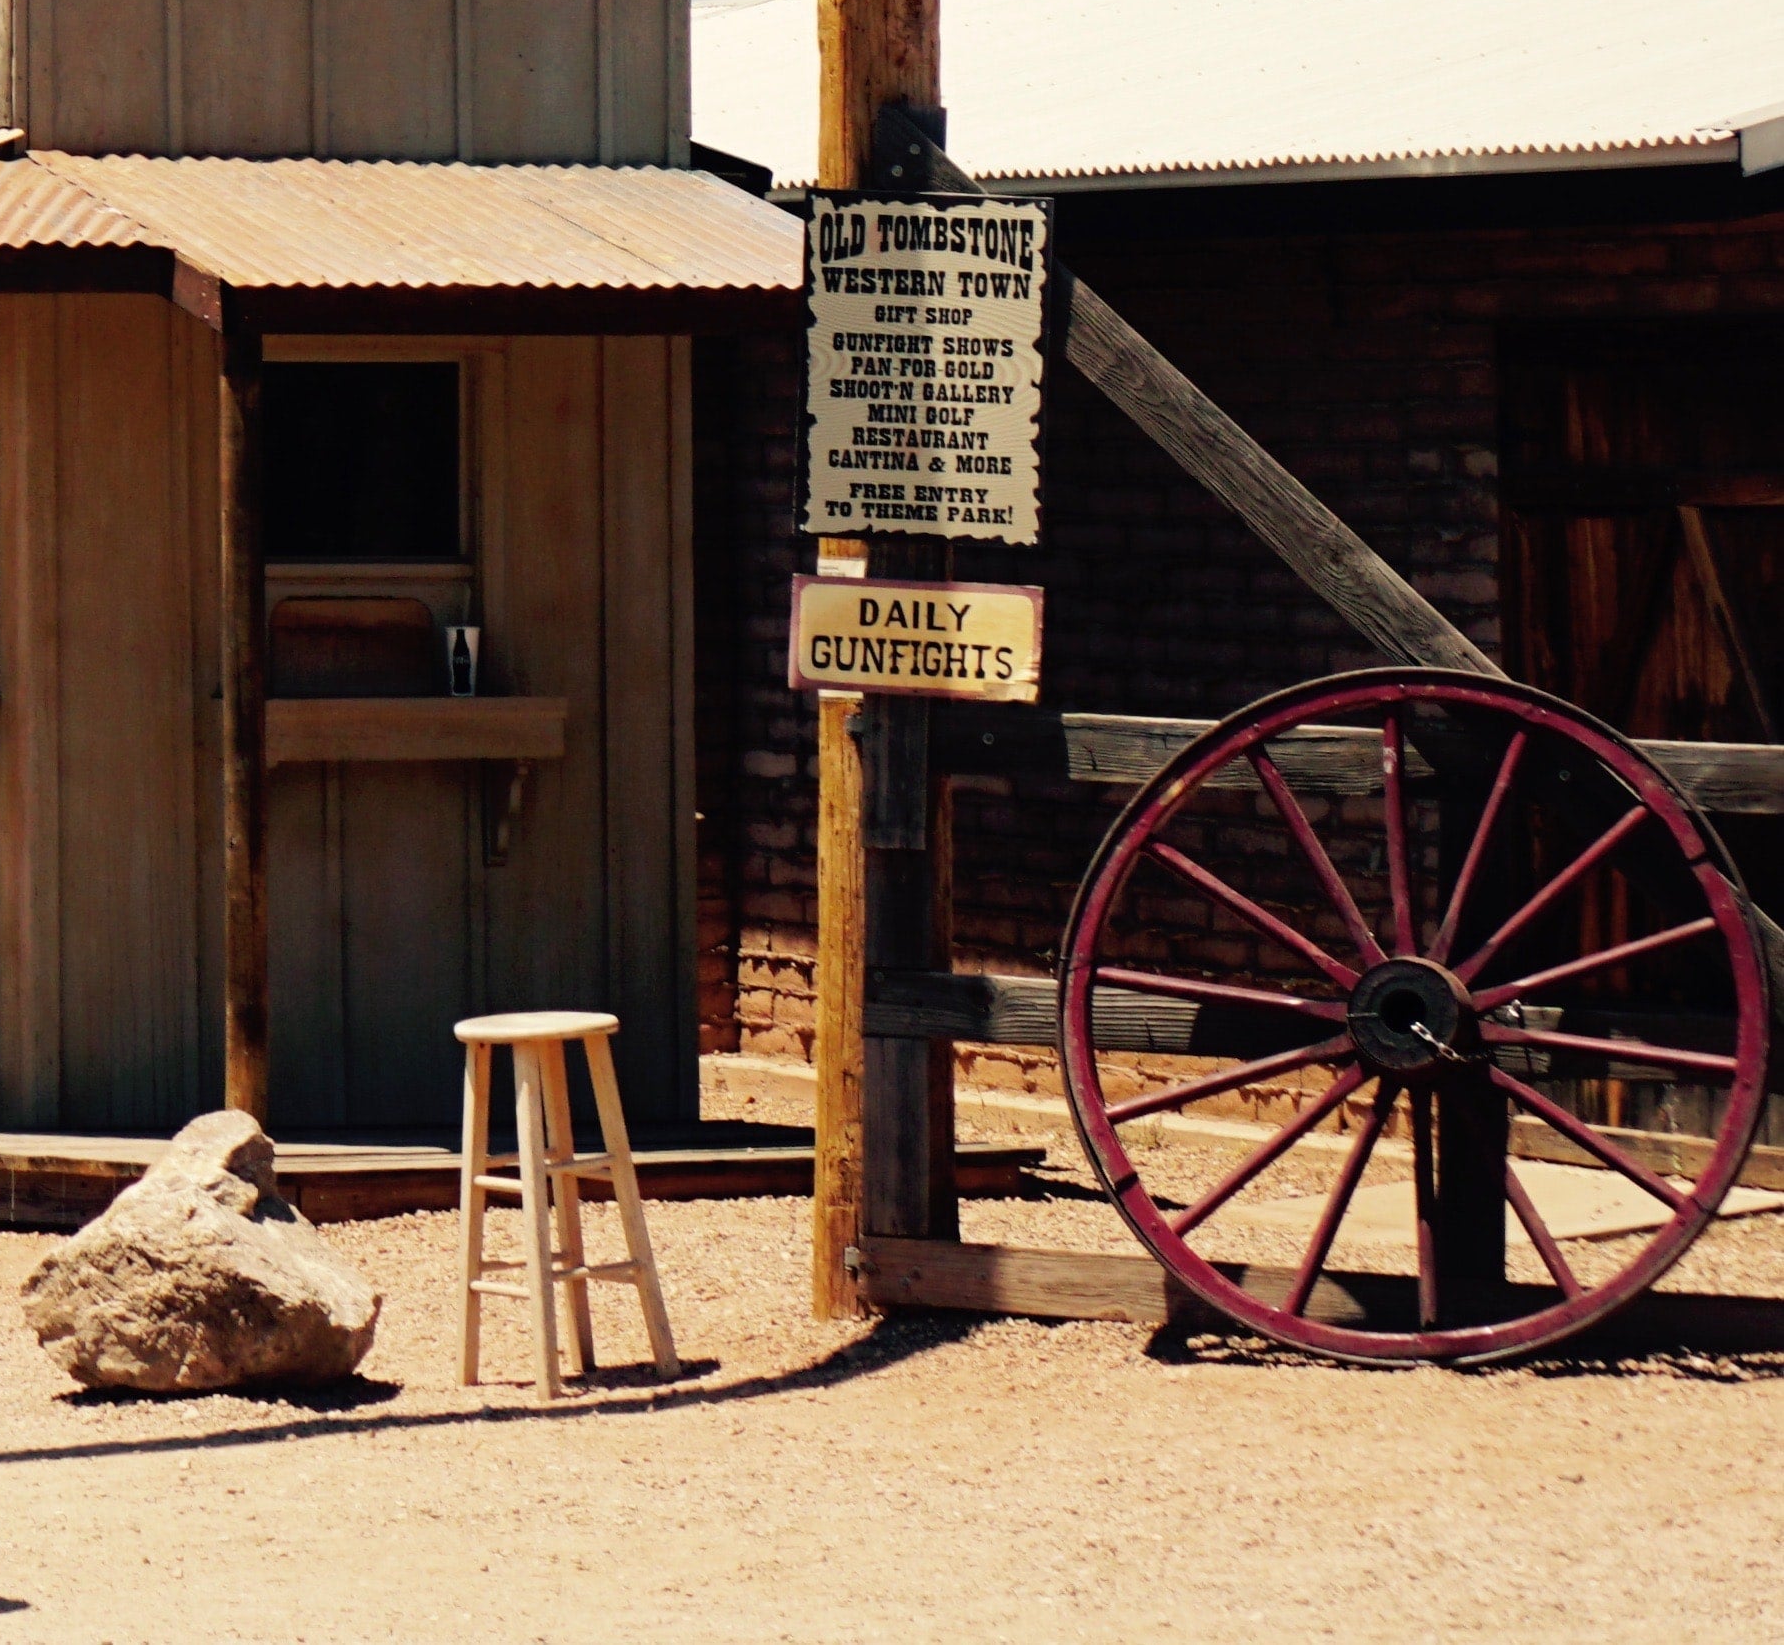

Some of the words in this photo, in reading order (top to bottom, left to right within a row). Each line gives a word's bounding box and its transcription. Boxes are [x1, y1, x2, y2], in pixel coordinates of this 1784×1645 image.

[820, 213, 865, 264] OLD
[877, 214, 1033, 273] TOMBSTONE
[822, 267, 945, 296] WESTERN
[958, 272, 1031, 299] TOWN
[874, 306, 918, 324] GIFT
[925, 307, 972, 325] SHOP
[833, 332, 933, 354] GUNFIGHT
[943, 337, 1013, 357] SHOWS
[851, 358, 993, 379] PAN-FOR-GOLD
[830, 379, 913, 400] SHOOT'N
[922, 382, 1014, 404] GALLERY
[868, 404, 916, 424] MINI
[926, 406, 974, 426] GOLF
[852, 427, 988, 450] RESTAURANT
[829, 450, 919, 471] CANTINA
[928, 457, 945, 472] &
[956, 455, 1011, 474] MORE
[850, 483, 904, 500] FREE
[914, 485, 988, 504] ENTRY
[826, 501, 851, 517] TO
[861, 503, 937, 521] THEME
[947, 506, 1012, 524] PARK!
[860, 598, 969, 631] DAILY
[811, 635, 1012, 679] GUNFIGHTS
